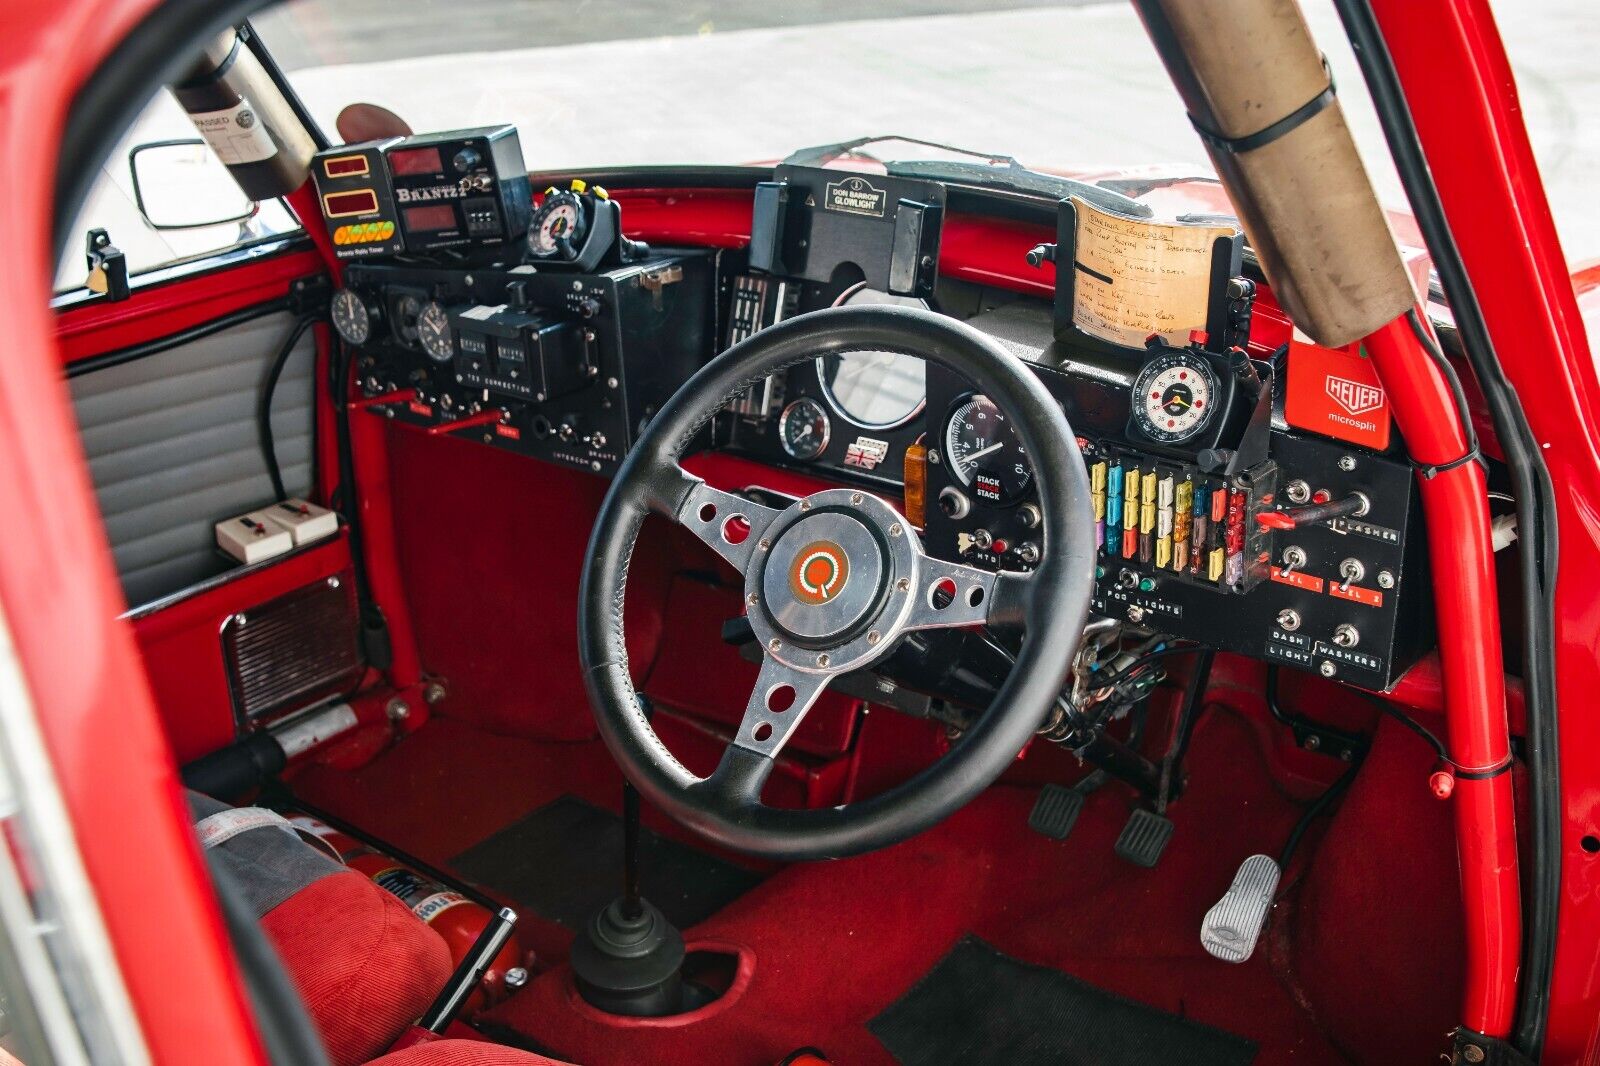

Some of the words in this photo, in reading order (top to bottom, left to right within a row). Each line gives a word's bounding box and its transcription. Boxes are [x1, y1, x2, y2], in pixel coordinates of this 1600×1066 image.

[396, 188, 458, 202] BRANTZ
[833, 189, 849, 197] DON
[849, 190, 880, 202] BARROW
[835, 196, 876, 210] GLOWLIGHT
[1331, 379, 1379, 411] HEUER
[1328, 413, 1376, 432] microsplit
[977, 475, 1000, 486] STACK
[977, 489, 1000, 500] STACK
[1274, 571, 1302, 584] FEL
[1331, 585, 1360, 598] FEL
[1107, 590, 1127, 601] FOG
[1136, 598, 1179, 615] LIGHTS
[1272, 631, 1303, 645] DASH
[1269, 646, 1309, 662] LIGHT
[1319, 646, 1376, 668] WASHERS
